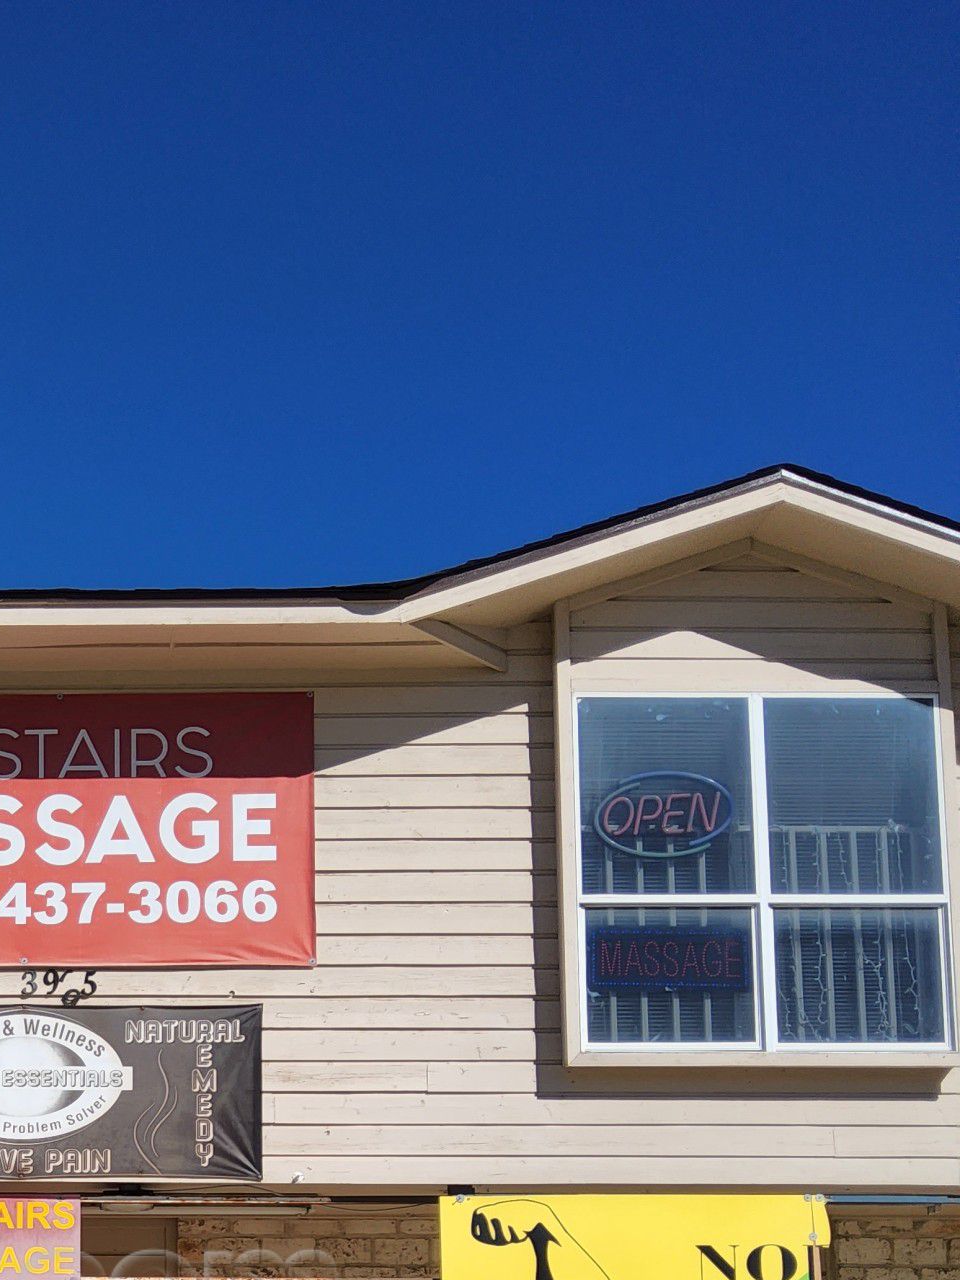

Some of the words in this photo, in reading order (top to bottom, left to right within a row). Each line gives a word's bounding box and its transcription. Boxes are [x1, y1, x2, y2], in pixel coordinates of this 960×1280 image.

[602, 791, 721, 837] OPEN
[600, 939, 742, 979] MASSAGE
[2, 1018, 15, 1037] &
[24, 1018, 106, 1058] Wellness
[124, 1018, 246, 1045] NATURAL
[1, 1069, 124, 1088] ESSENTIALS
[3, 1118, 62, 1134] Problem
[66, 1095, 107, 1126] Solver
[44, 1147, 112, 1175] PAIN
